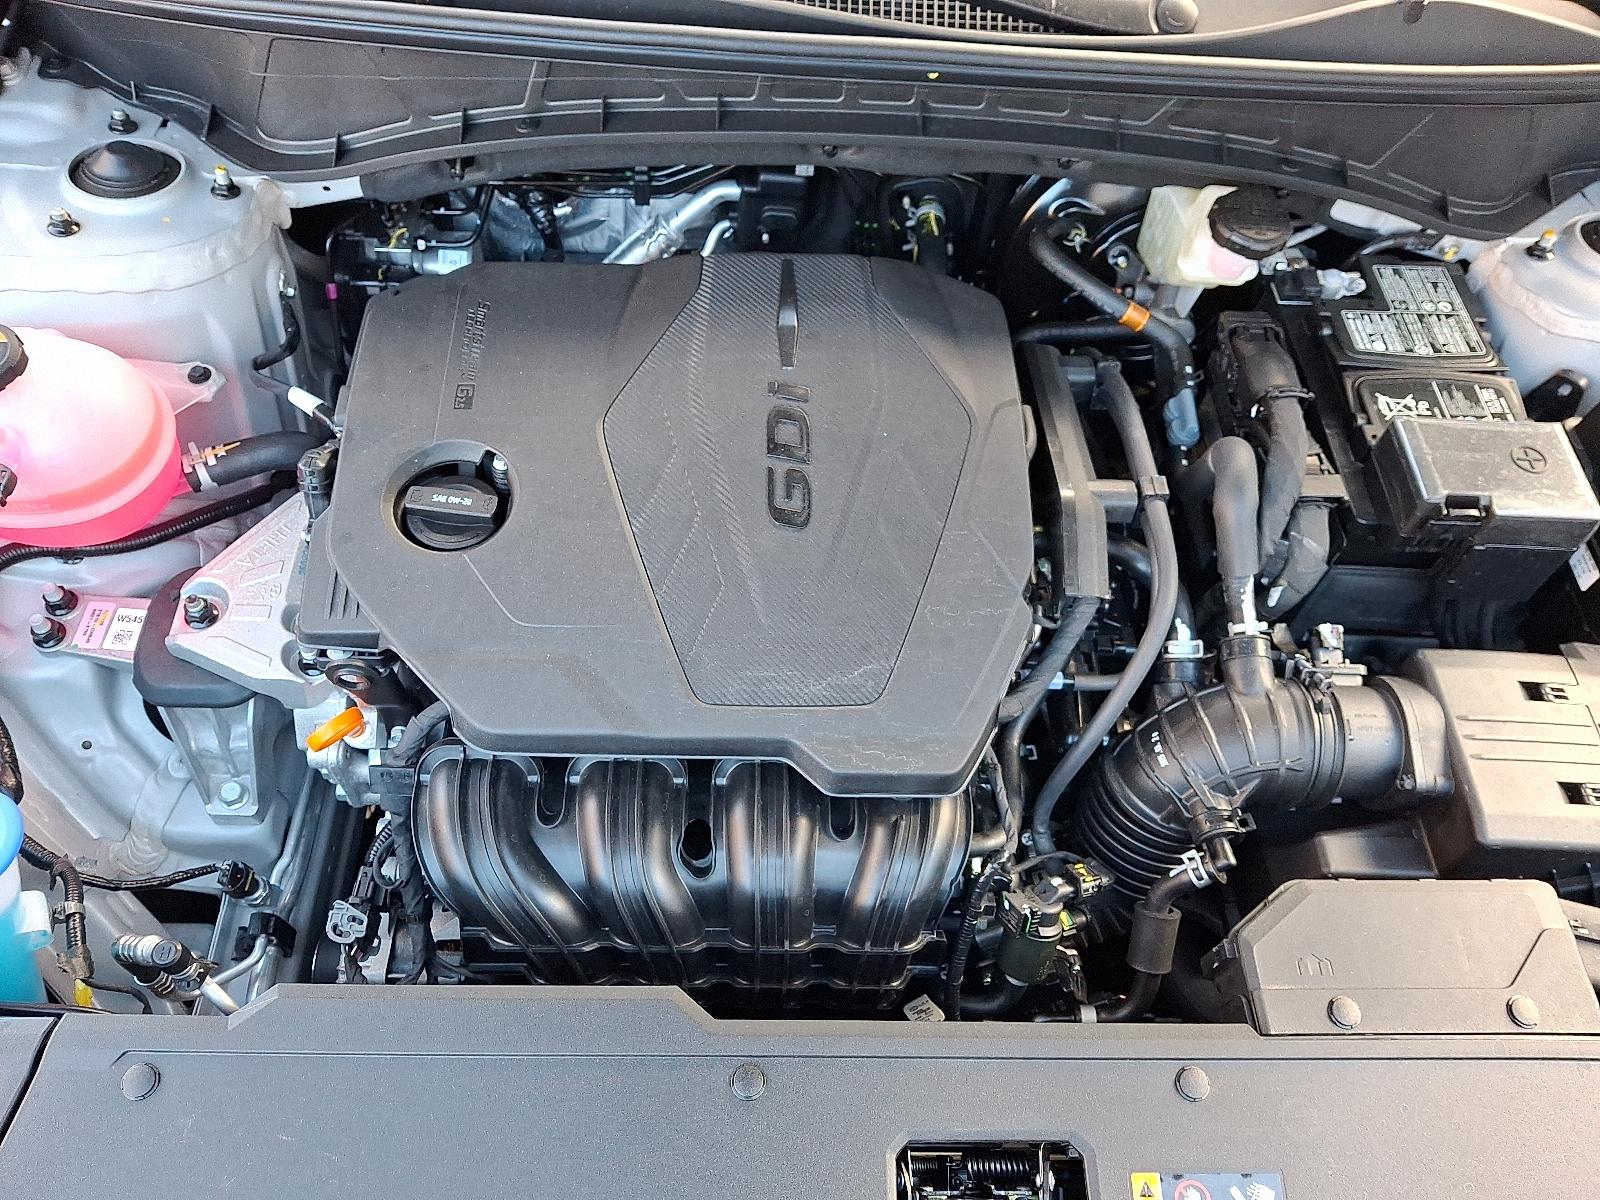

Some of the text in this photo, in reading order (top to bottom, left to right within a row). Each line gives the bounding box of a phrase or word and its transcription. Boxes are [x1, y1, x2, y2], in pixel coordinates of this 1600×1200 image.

[467, 299, 491, 381] Smartstream
[766, 381, 811, 529] GDi
[432, 494, 473, 506] SAE 0W-20
